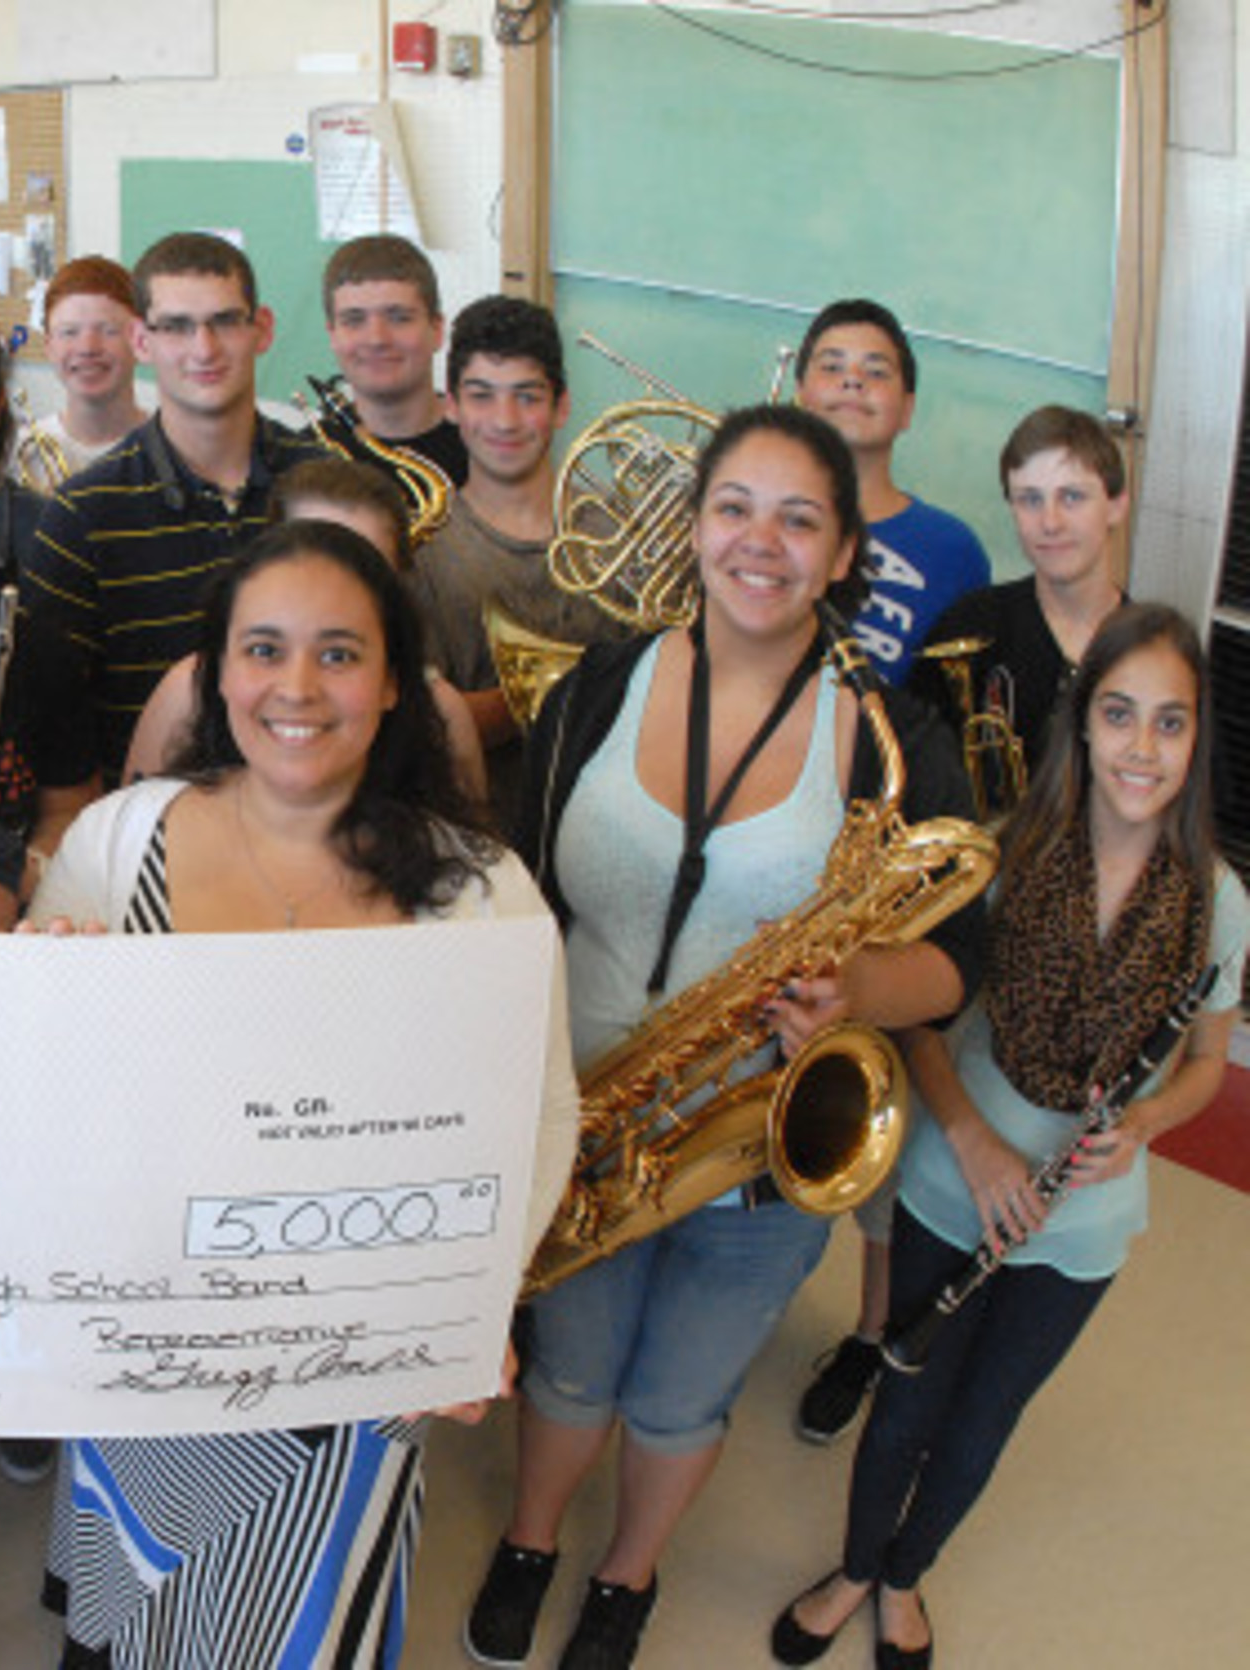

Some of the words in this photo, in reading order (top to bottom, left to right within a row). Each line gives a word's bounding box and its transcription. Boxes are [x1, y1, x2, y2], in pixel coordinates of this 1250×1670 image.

[852, 537, 925, 684] AER
[48, 1270, 173, 1300] School
[200, 1267, 310, 1300] Band
